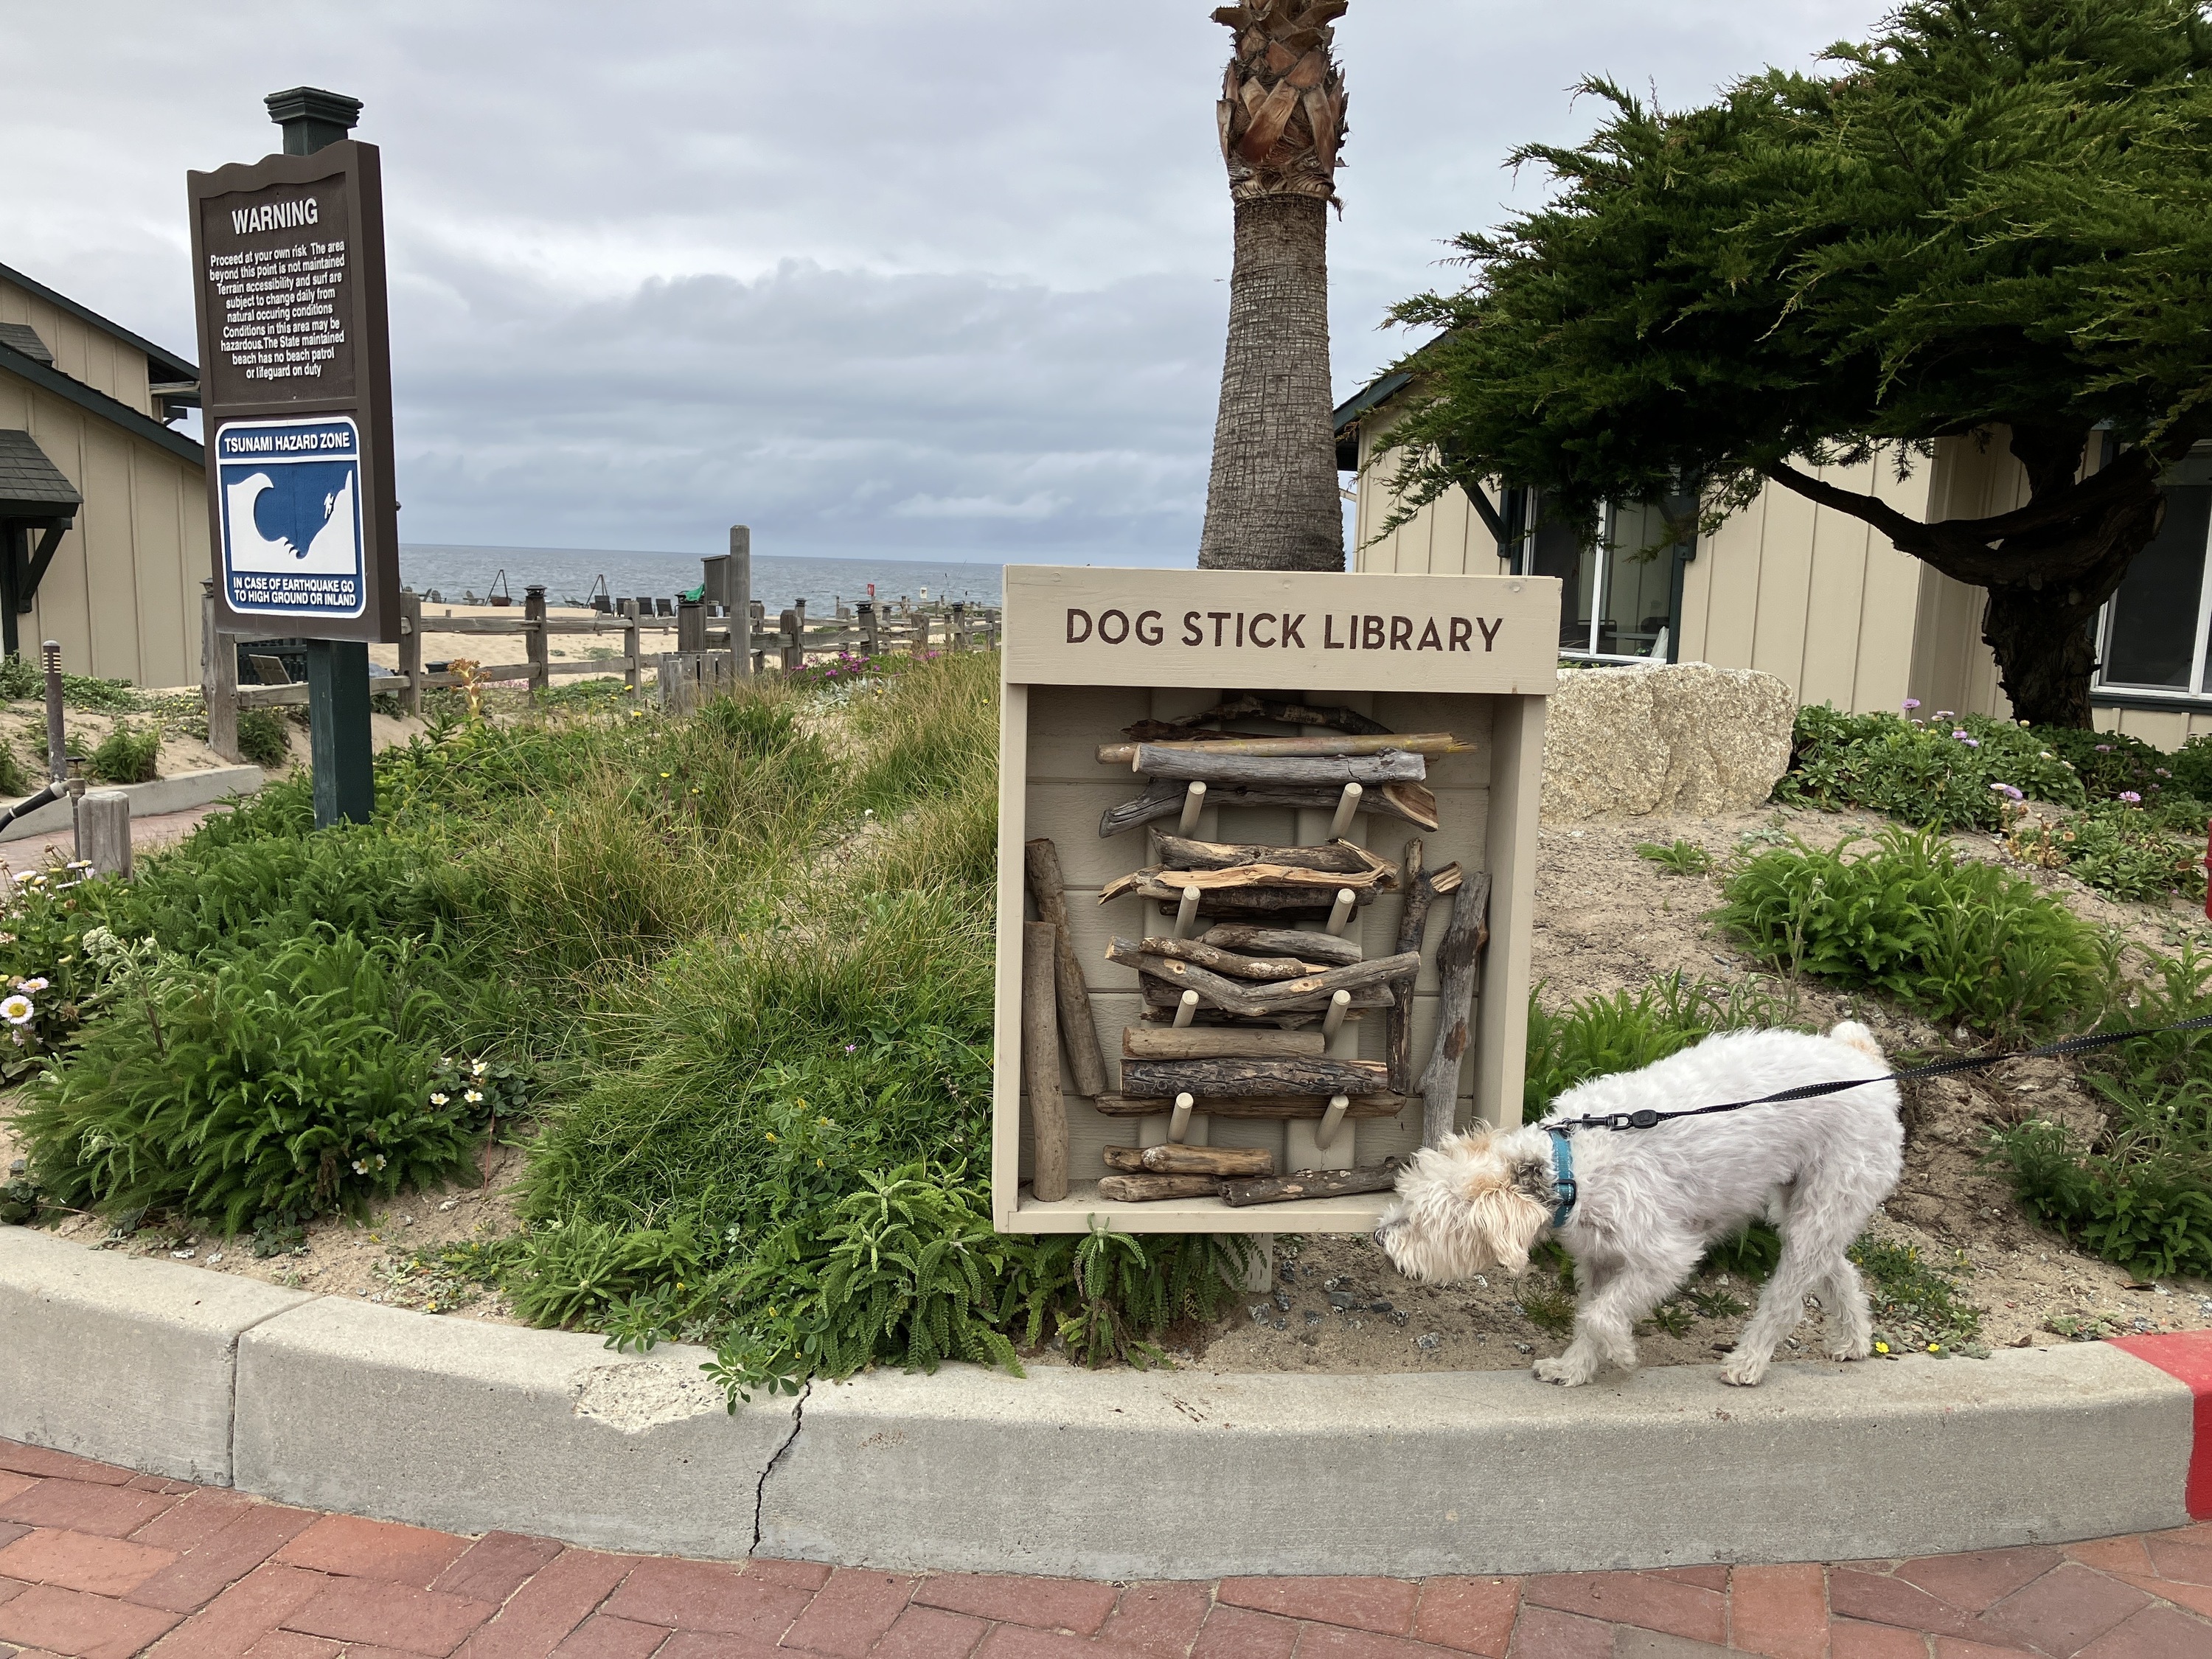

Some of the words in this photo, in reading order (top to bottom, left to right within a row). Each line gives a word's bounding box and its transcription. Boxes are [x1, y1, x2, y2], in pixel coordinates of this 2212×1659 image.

[232, 198, 319, 234] WARNING
[210, 251, 243, 267] Proceed
[245, 253, 253, 263] at
[254, 251, 272, 265] your
[274, 248, 291, 259] own
[293, 245, 307, 257] risk
[310, 243, 326, 255] The
[328, 241, 344, 251] area
[209, 267, 238, 282] beyond
[240, 265, 255, 278] this
[257, 262, 277, 279] point
[279, 262, 286, 274] is
[288, 260, 301, 273] not
[303, 254, 345, 271] maintained
[217, 282, 244, 295] Terrain
[246, 276, 294, 291] accessibility
[296, 274, 310, 288] and
[313, 272, 328, 284] surf
[330, 272, 342, 283] are
[226, 296, 254, 310] subject
[256, 294, 264, 306] to
[265, 293, 295, 306] change
[296, 290, 315, 303] daily
[317, 288, 335, 300] from
[227, 310, 254, 323] natural
[257, 307, 290, 321] occuring
[293, 304, 333, 318] conditions
[223, 324, 265, 338] Conditions
[268, 323, 274, 335] in
[276, 322, 291, 334] this
[293, 322, 310, 333] area
[312, 320, 328, 333] may
[330, 317, 340, 330] be
[280, 336, 300, 347] State
[302, 330, 344, 346] maintained
[232, 352, 257, 365] beach
[258, 352, 273, 364] has
[274, 352, 284, 363] no
[286, 349, 310, 362] beach
[312, 347, 335, 362] patrol
[246, 369, 254, 379] or
[257, 364, 291, 380] lifeguard
[293, 366, 302, 376] on
[305, 363, 321, 378] duty
[224, 437, 273, 452] TSUNAMI
[276, 434, 318, 451] HAZARD
[320, 432, 349, 448] ZONE
[234, 577, 242, 588] IN
[245, 577, 267, 590] CASE
[269, 578, 281, 590] OF
[283, 579, 339, 592] EARTHQUAKE
[341, 581, 354, 593] GO
[234, 590, 246, 602] TO
[248, 591, 270, 603] HIGH
[271, 591, 308, 605] GROUND
[310, 593, 323, 605] OR
[324, 594, 355, 606] INLAND
[1065, 608, 1164, 645] DOG
[1181, 611, 1307, 649] STICK
[1324, 614, 1503, 652] LIBRARY
